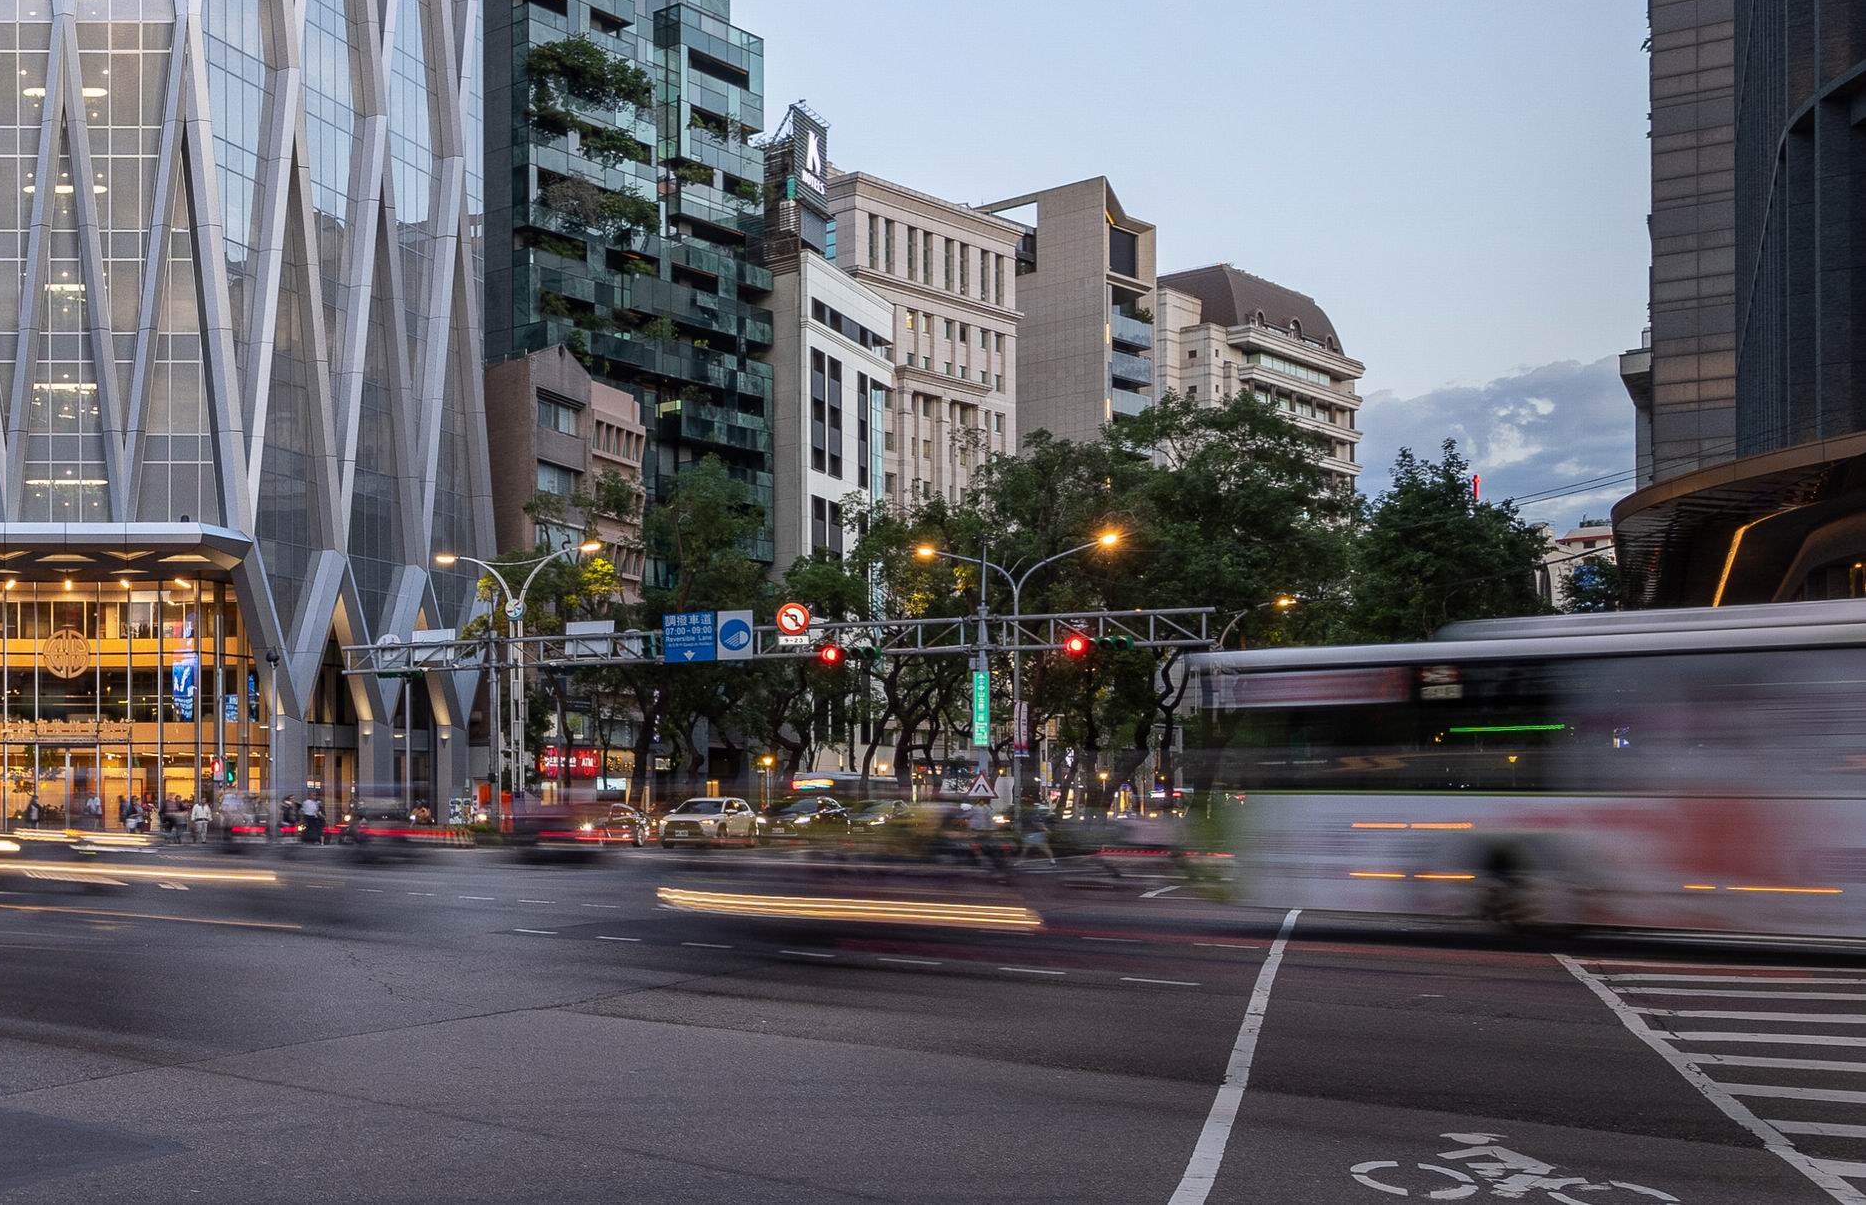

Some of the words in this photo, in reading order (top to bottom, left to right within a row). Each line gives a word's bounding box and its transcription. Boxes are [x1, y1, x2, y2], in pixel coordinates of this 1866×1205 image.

[802, 169, 825, 195] HOTELS
[665, 614, 712, 626] 調撥車道
